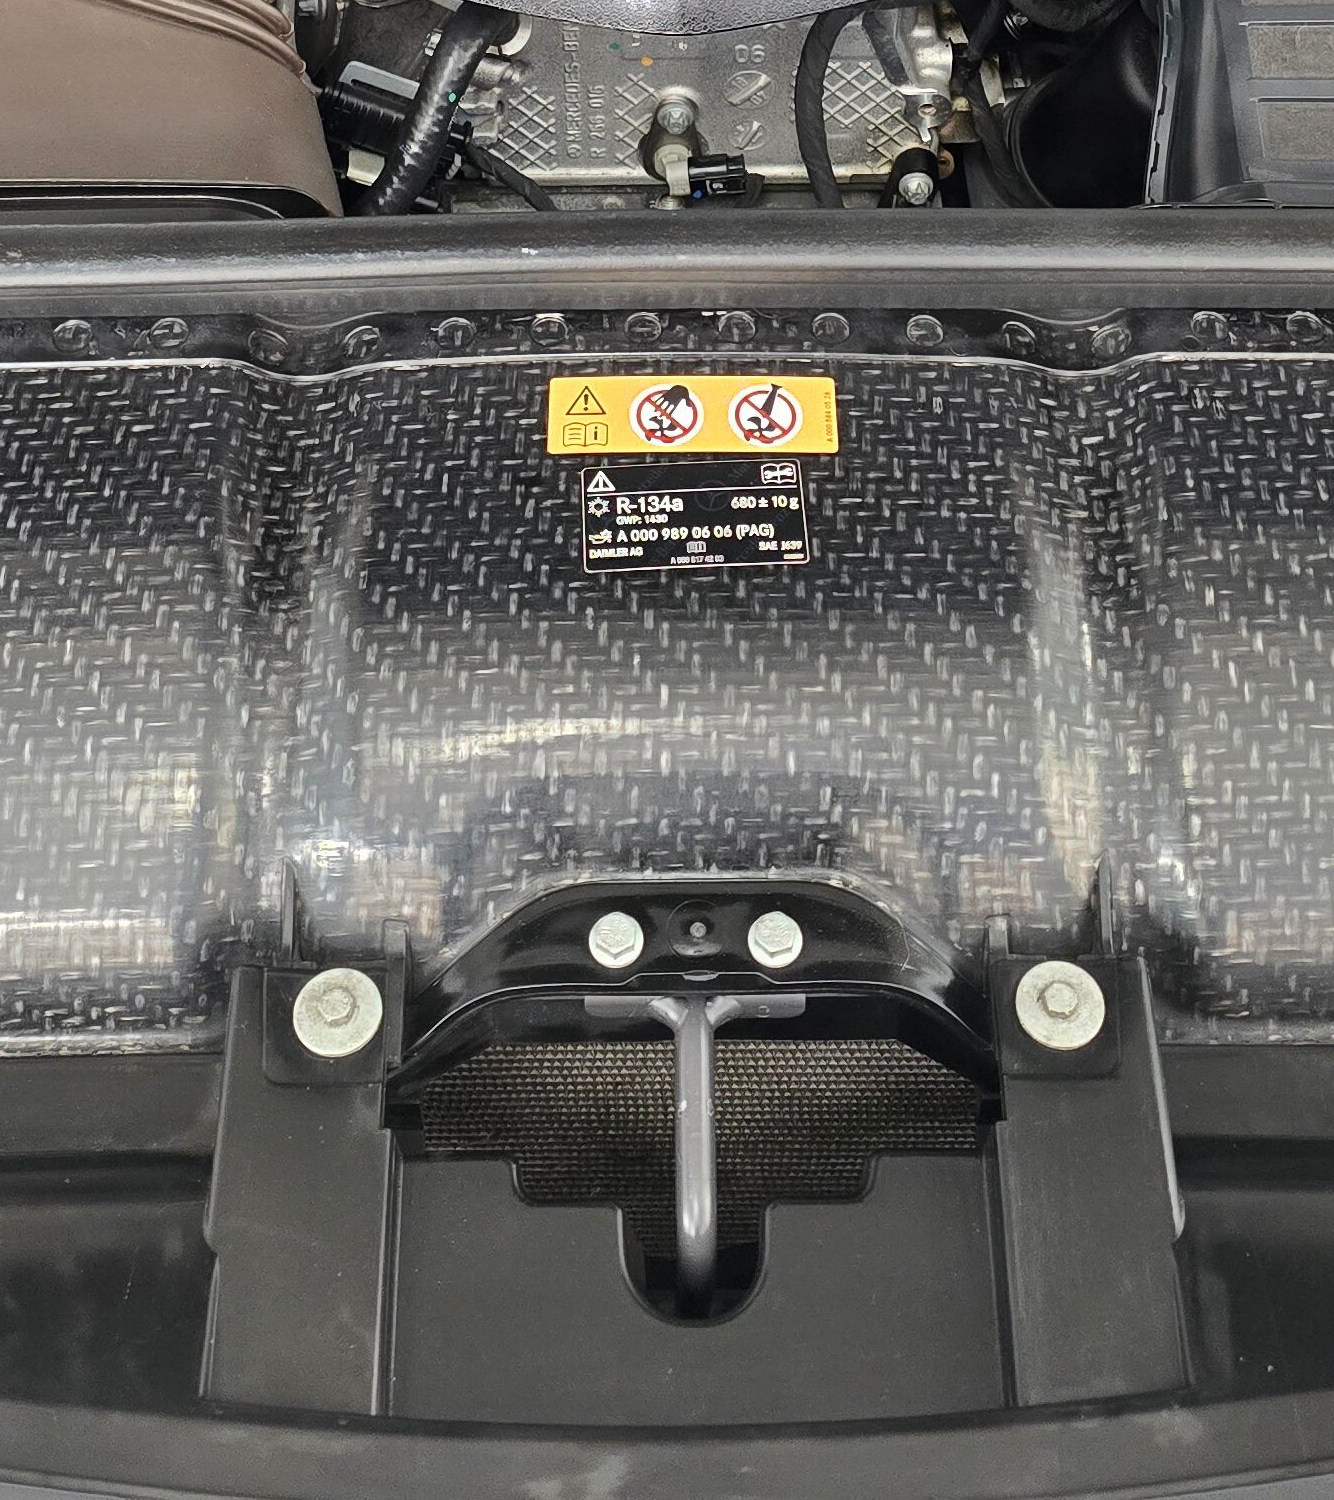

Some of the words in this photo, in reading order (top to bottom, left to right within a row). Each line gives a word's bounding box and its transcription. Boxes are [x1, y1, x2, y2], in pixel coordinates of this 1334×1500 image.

[562, 22, 582, 142] MERCEDES-BEN
[616, 495, 684, 514] R-134a
[730, 496, 756, 509] 680
[772, 495, 787, 507] 10
[789, 496, 799, 510] g
[616, 515, 642, 525] GWP:
[616, 530, 628, 543] A
[630, 529, 658, 541] 000
[663, 527, 688, 540] 989
[692, 526, 710, 538] 06
[714, 525, 732, 537] 06
[736, 523, 774, 540] (PAG)
[589, 548, 628, 559] DAIMLER
[758, 542, 777, 551] SAE
